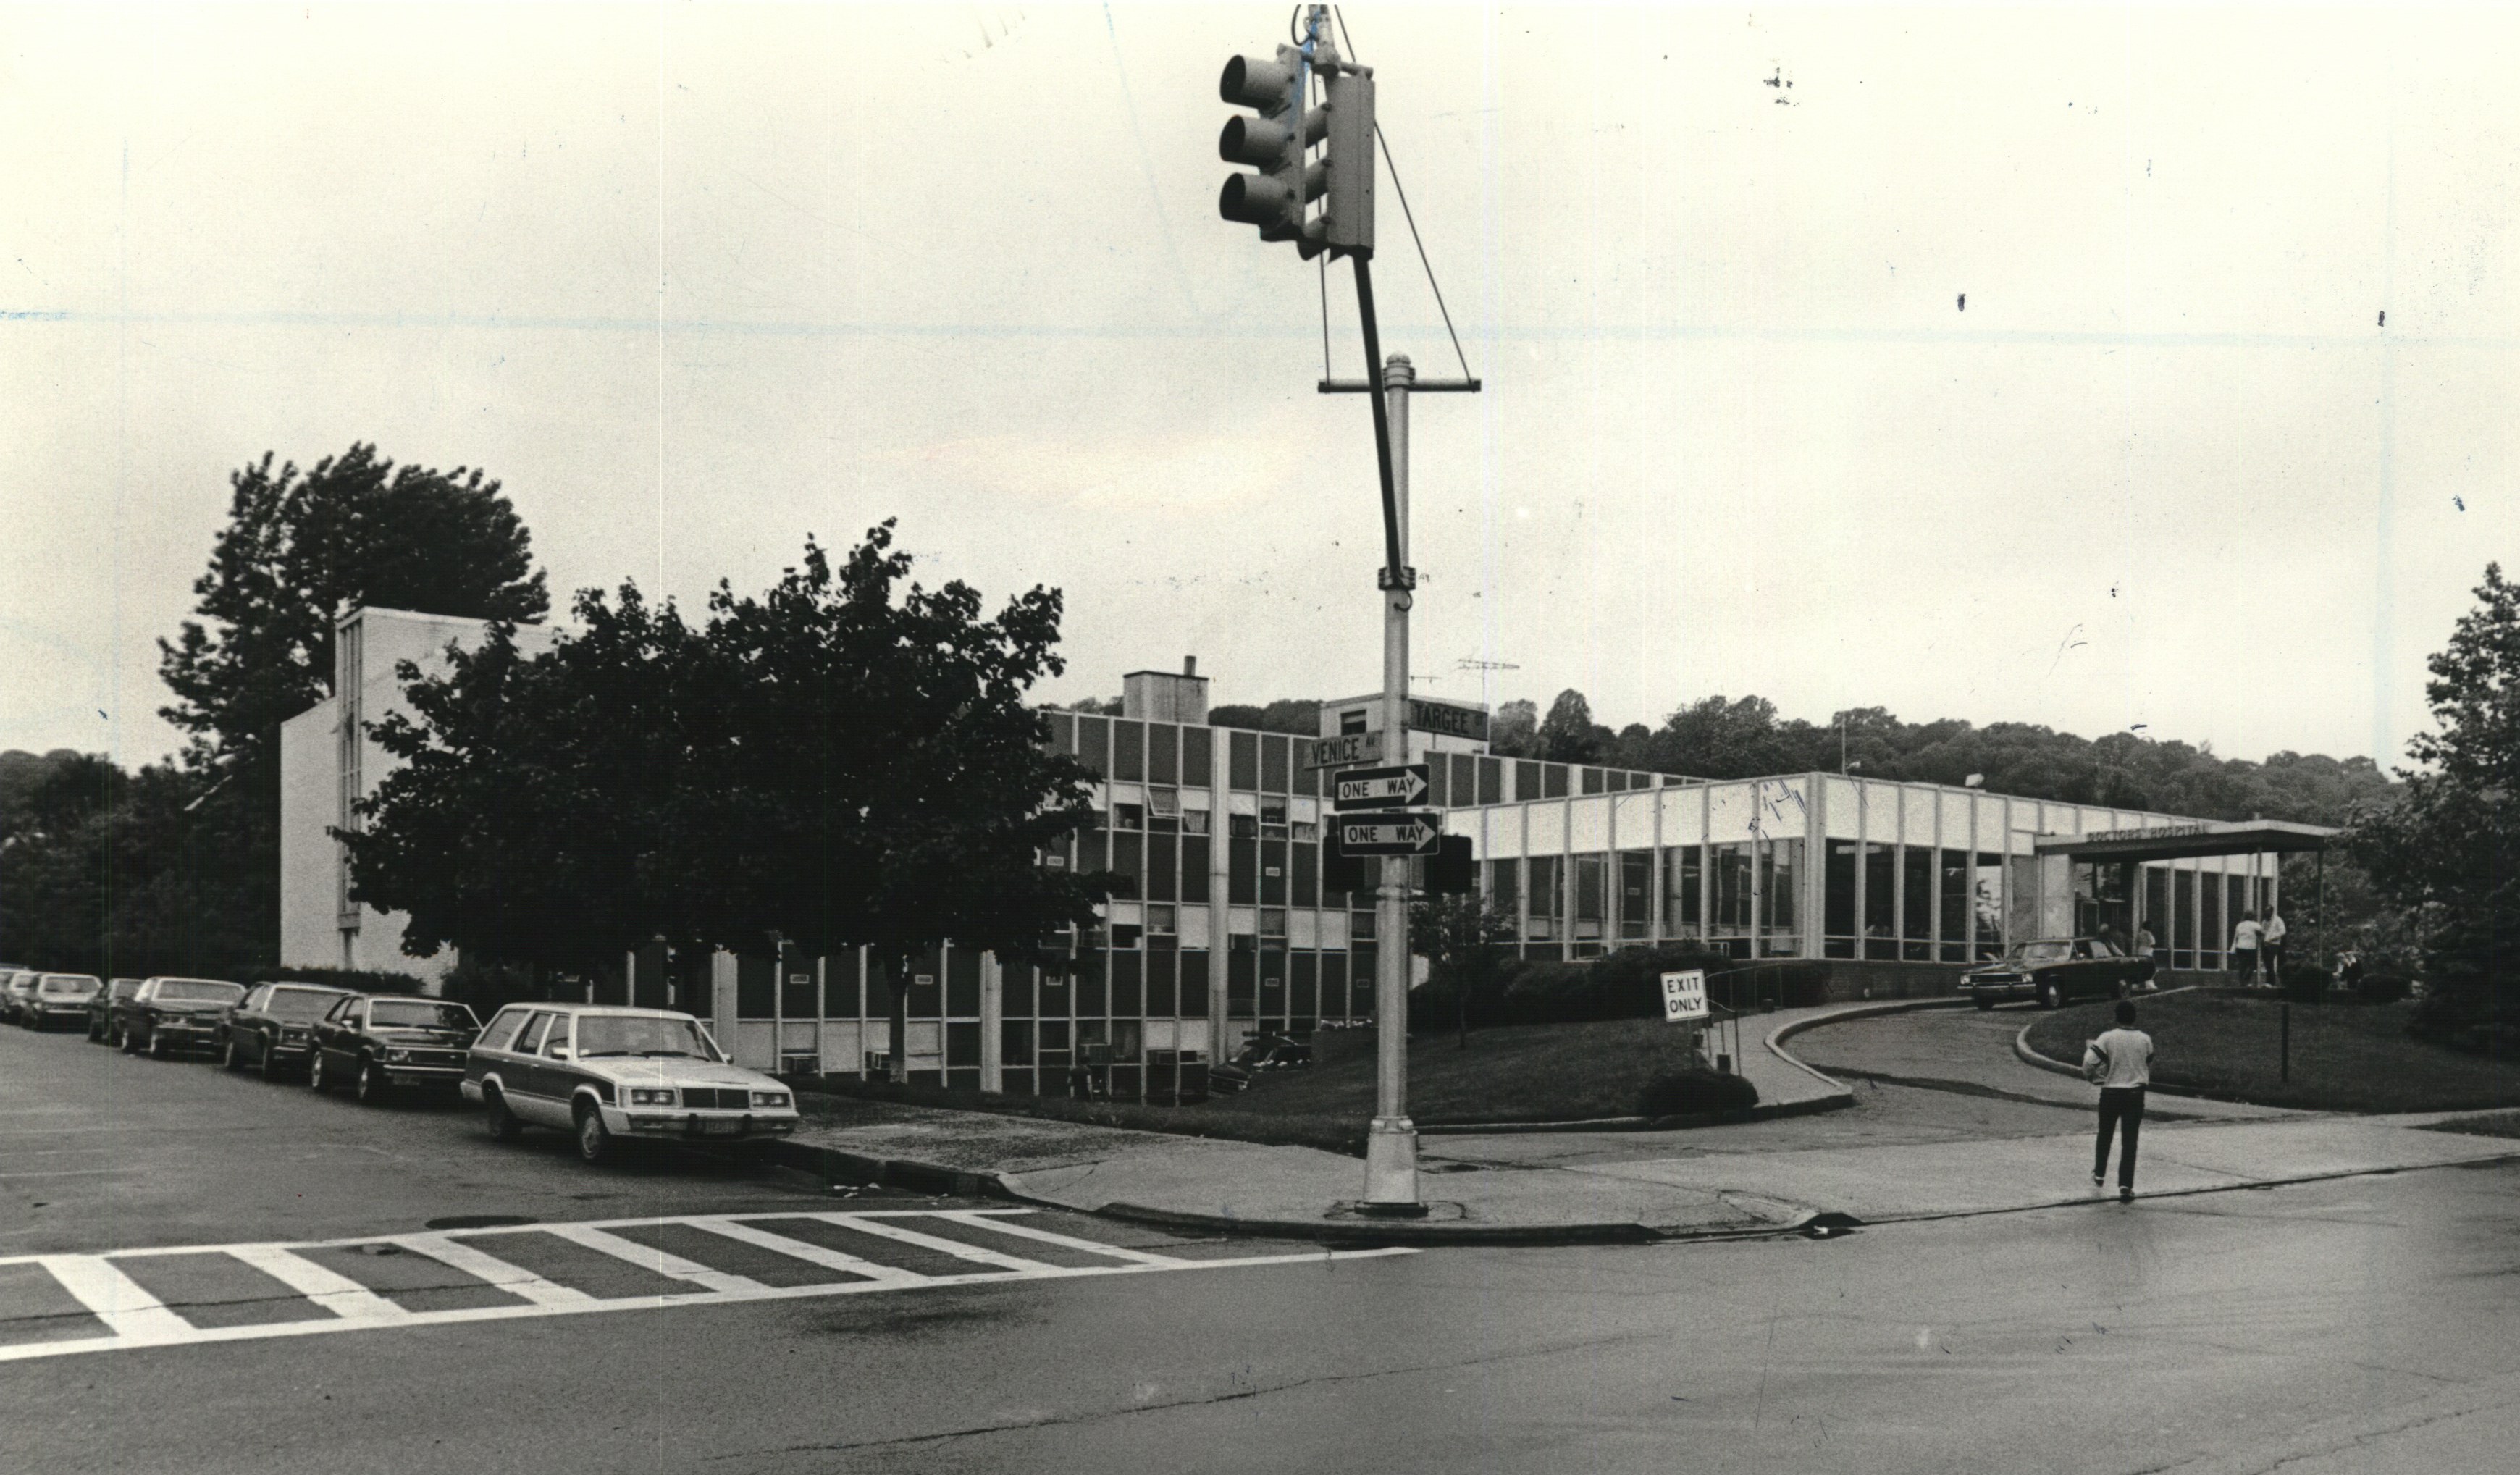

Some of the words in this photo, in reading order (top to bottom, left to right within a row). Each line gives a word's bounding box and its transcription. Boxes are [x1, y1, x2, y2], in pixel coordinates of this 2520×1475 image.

[1414, 704, 1469, 734] TARGEE
[1311, 738, 1360, 765] VENICE
[1343, 782, 1369, 798] ONE
[1387, 778, 1415, 794] WAY
[1348, 826, 1378, 842] ONE
[1396, 825, 1424, 841] WAY
[2087, 828, 2141, 842] DOCTORS
[1667, 977, 1699, 993] EXIT
[1669, 997, 1702, 1013] ONLY
